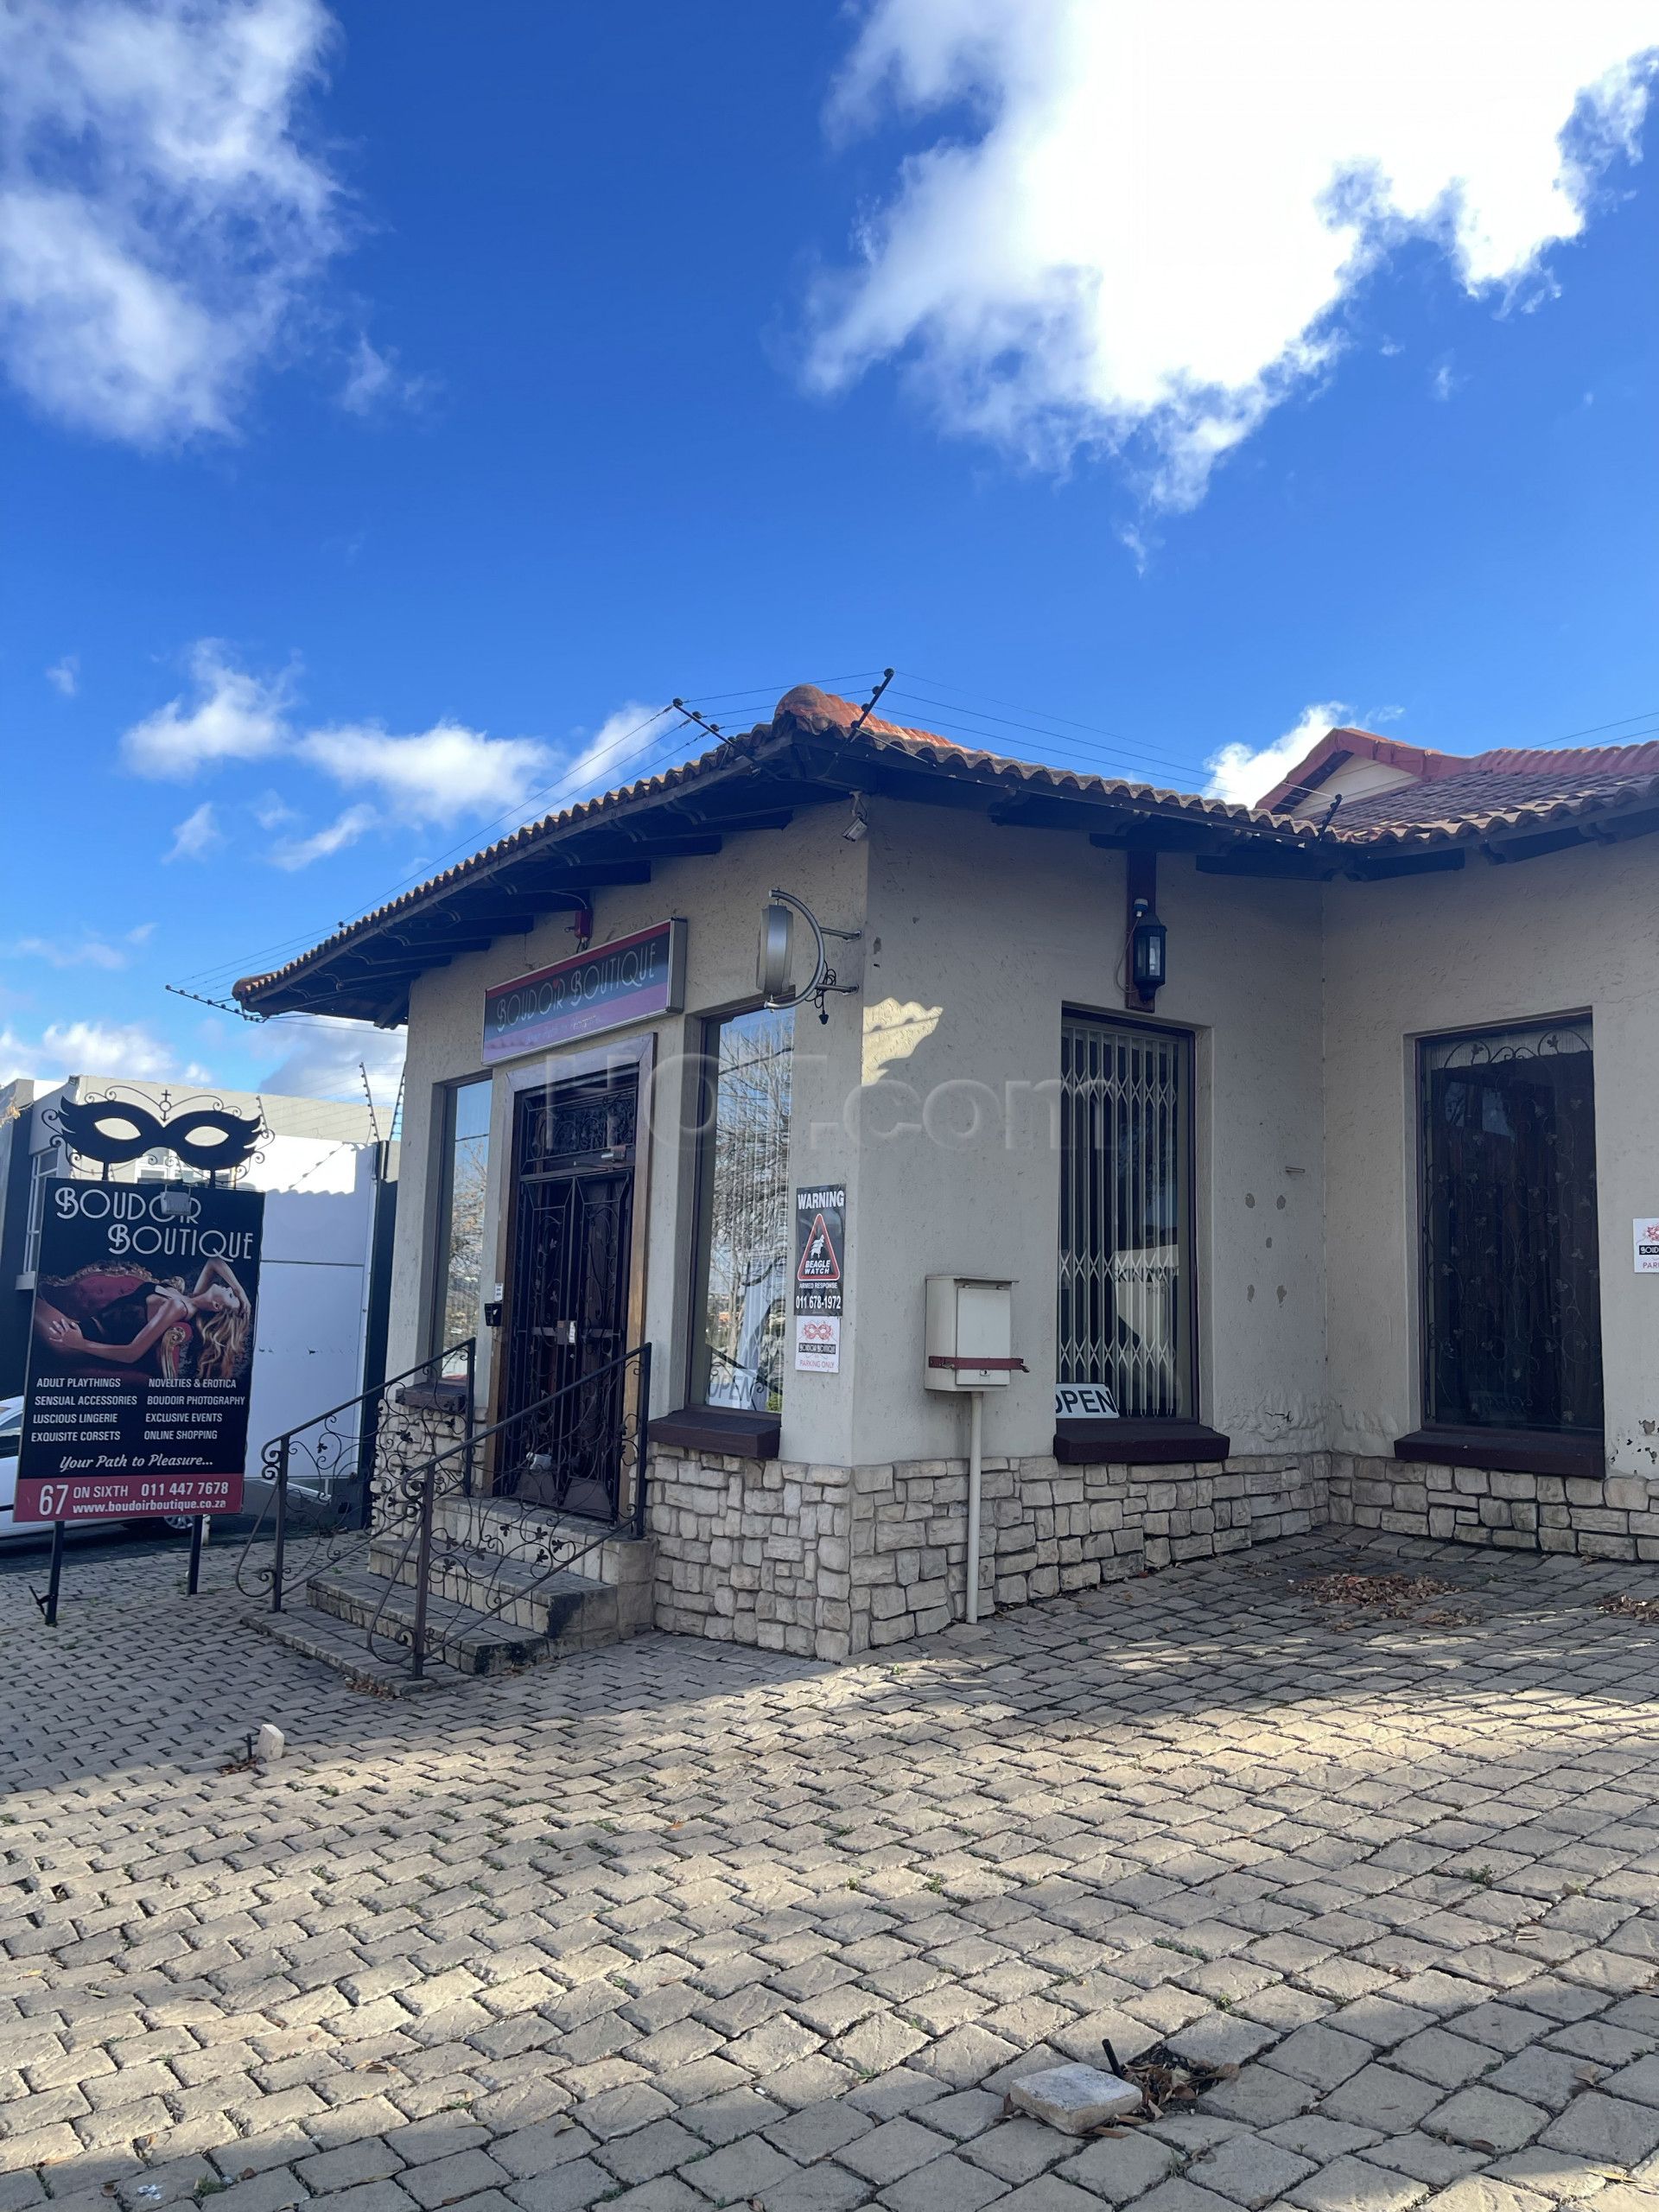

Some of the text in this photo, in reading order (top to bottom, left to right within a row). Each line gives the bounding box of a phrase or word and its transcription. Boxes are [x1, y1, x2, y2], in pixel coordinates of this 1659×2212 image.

[497, 978, 566, 1033] BOUDOIR
[570, 943, 656, 1007] BOUTIQUE
[798, 1190, 845, 1210] WARNING
[107, 1224, 254, 1262] BOUTIQUE
[804, 1260, 831, 1268] BEAGLE
[796, 1295, 842, 1309] 011 678-1972
[800, 1359, 835, 1369] PARKING ONLY
[36, 1377, 121, 1388] ADULT PLAYTHINGS
[148, 1378, 237, 1389] NOVELTIES & EROTICA
[35, 1395, 138, 1406] SENSUAL ACCESSORIES
[147, 1395, 245, 1406] BOUDOIR PHOTOGRAPHY
[33, 1413, 118, 1424] LUSCIOUS LINGERIE
[145, 1413, 223, 1422] EXCLUSIVE EVENTS
[31, 1431, 121, 1442] EXQUISITE CORSETS
[143, 1430, 218, 1440] ONLINE SHOPPING
[59, 1452, 213, 1473] Your Path to Pleasure...
[39, 1482, 229, 1516] 67 ON SIXTH 011 447 7678
[73, 1498, 226, 1514] www.boudoirboutique.co.za
